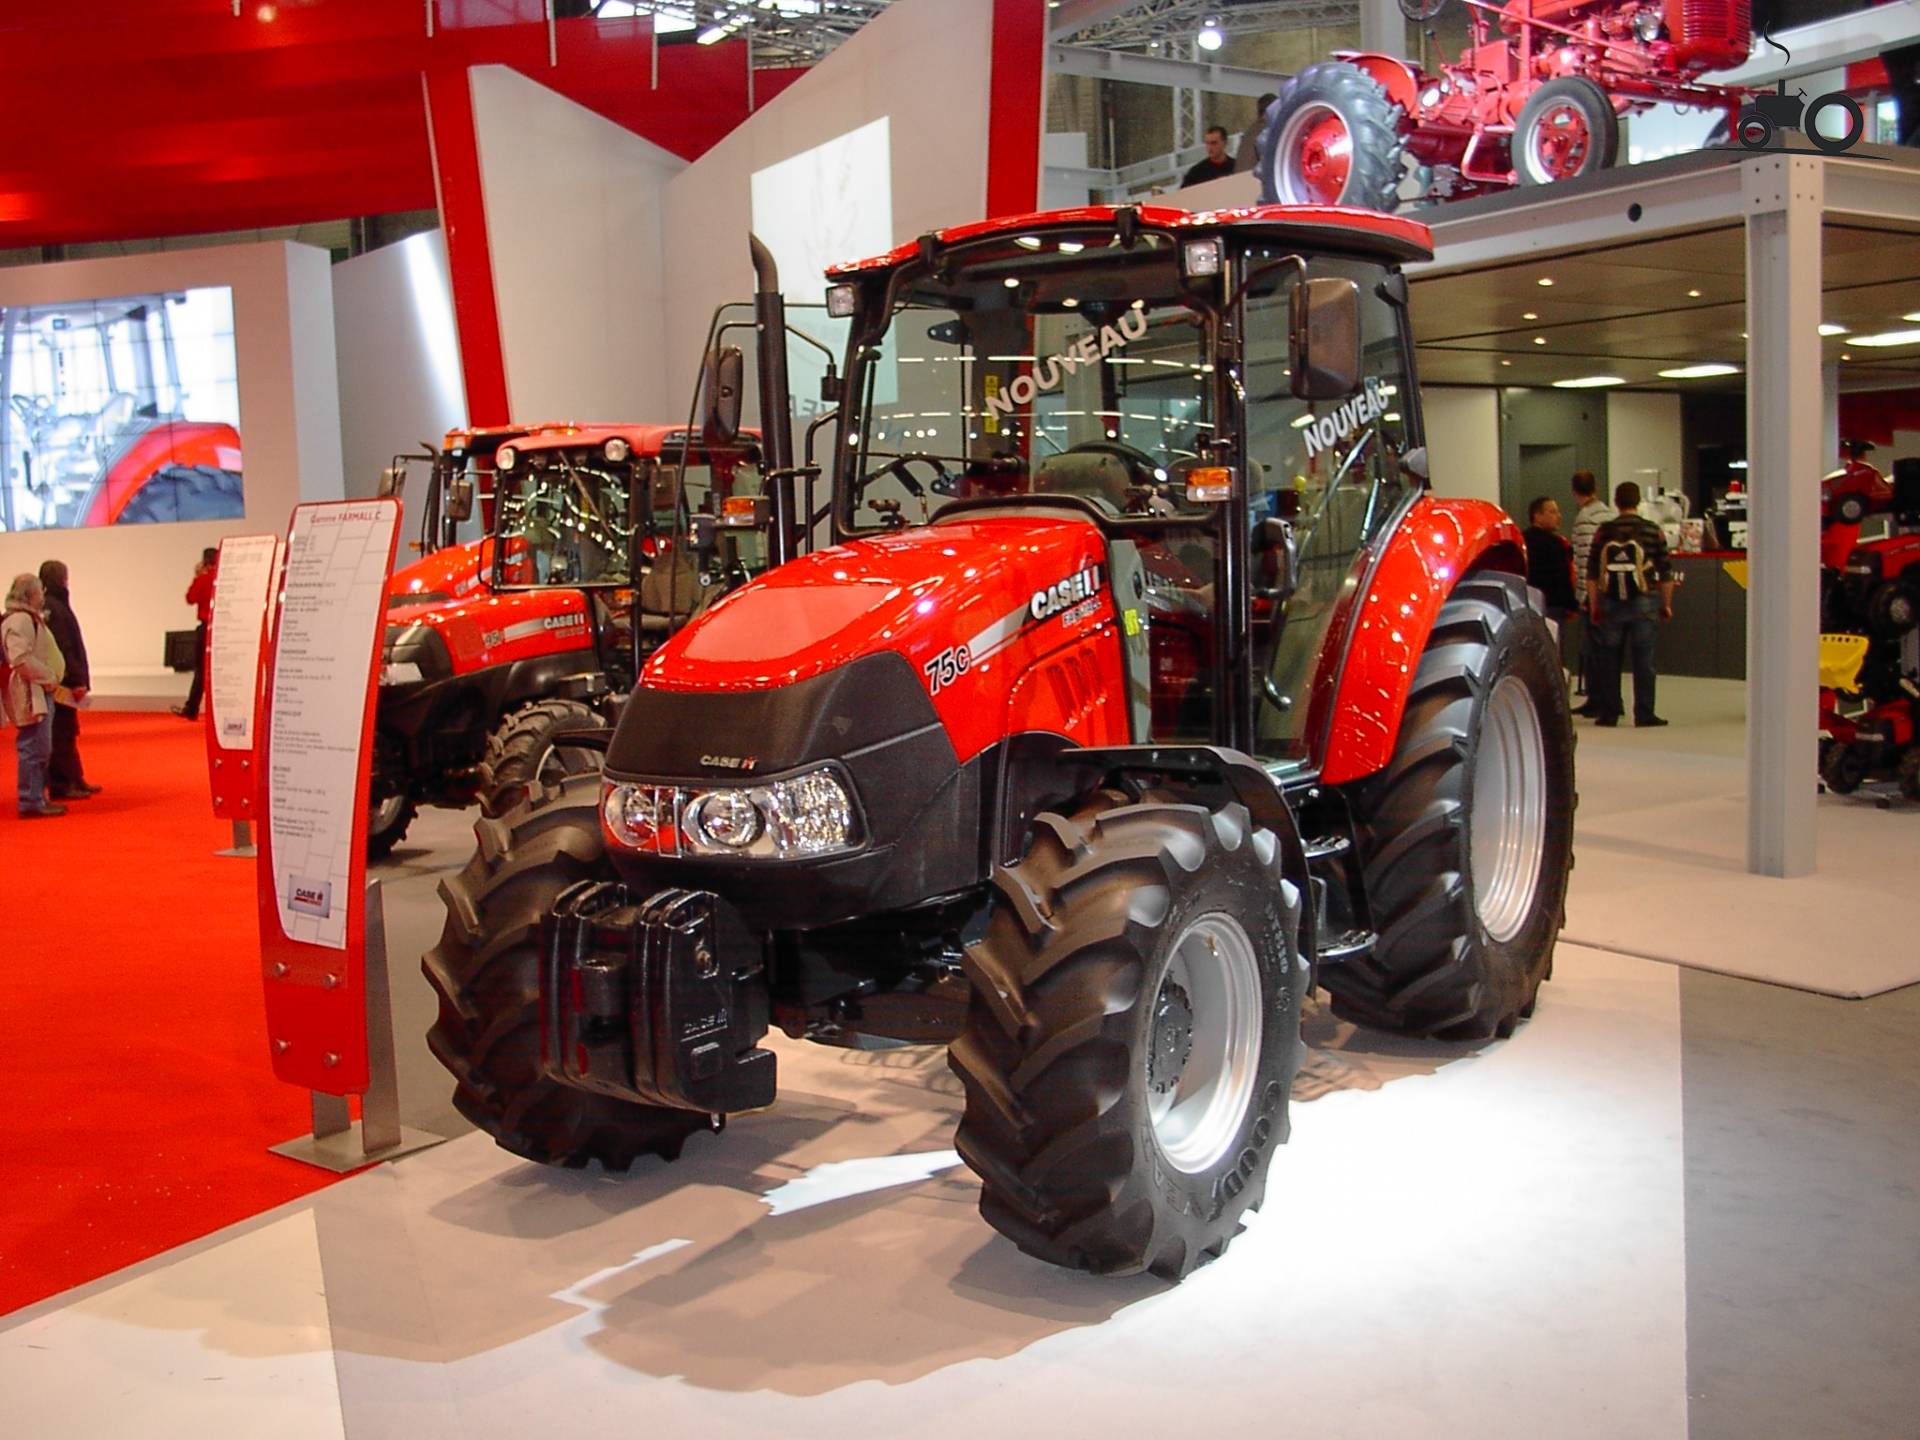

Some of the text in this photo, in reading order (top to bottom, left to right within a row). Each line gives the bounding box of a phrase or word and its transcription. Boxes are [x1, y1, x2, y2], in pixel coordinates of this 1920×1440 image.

[985, 308, 1148, 421] NOUVEAU
[1303, 380, 1389, 458] NOUVEAU
[1031, 573, 1084, 619] CASE
[543, 614, 573, 629] CASE
[925, 646, 970, 695] 75C
[700, 754, 740, 768] CASE
